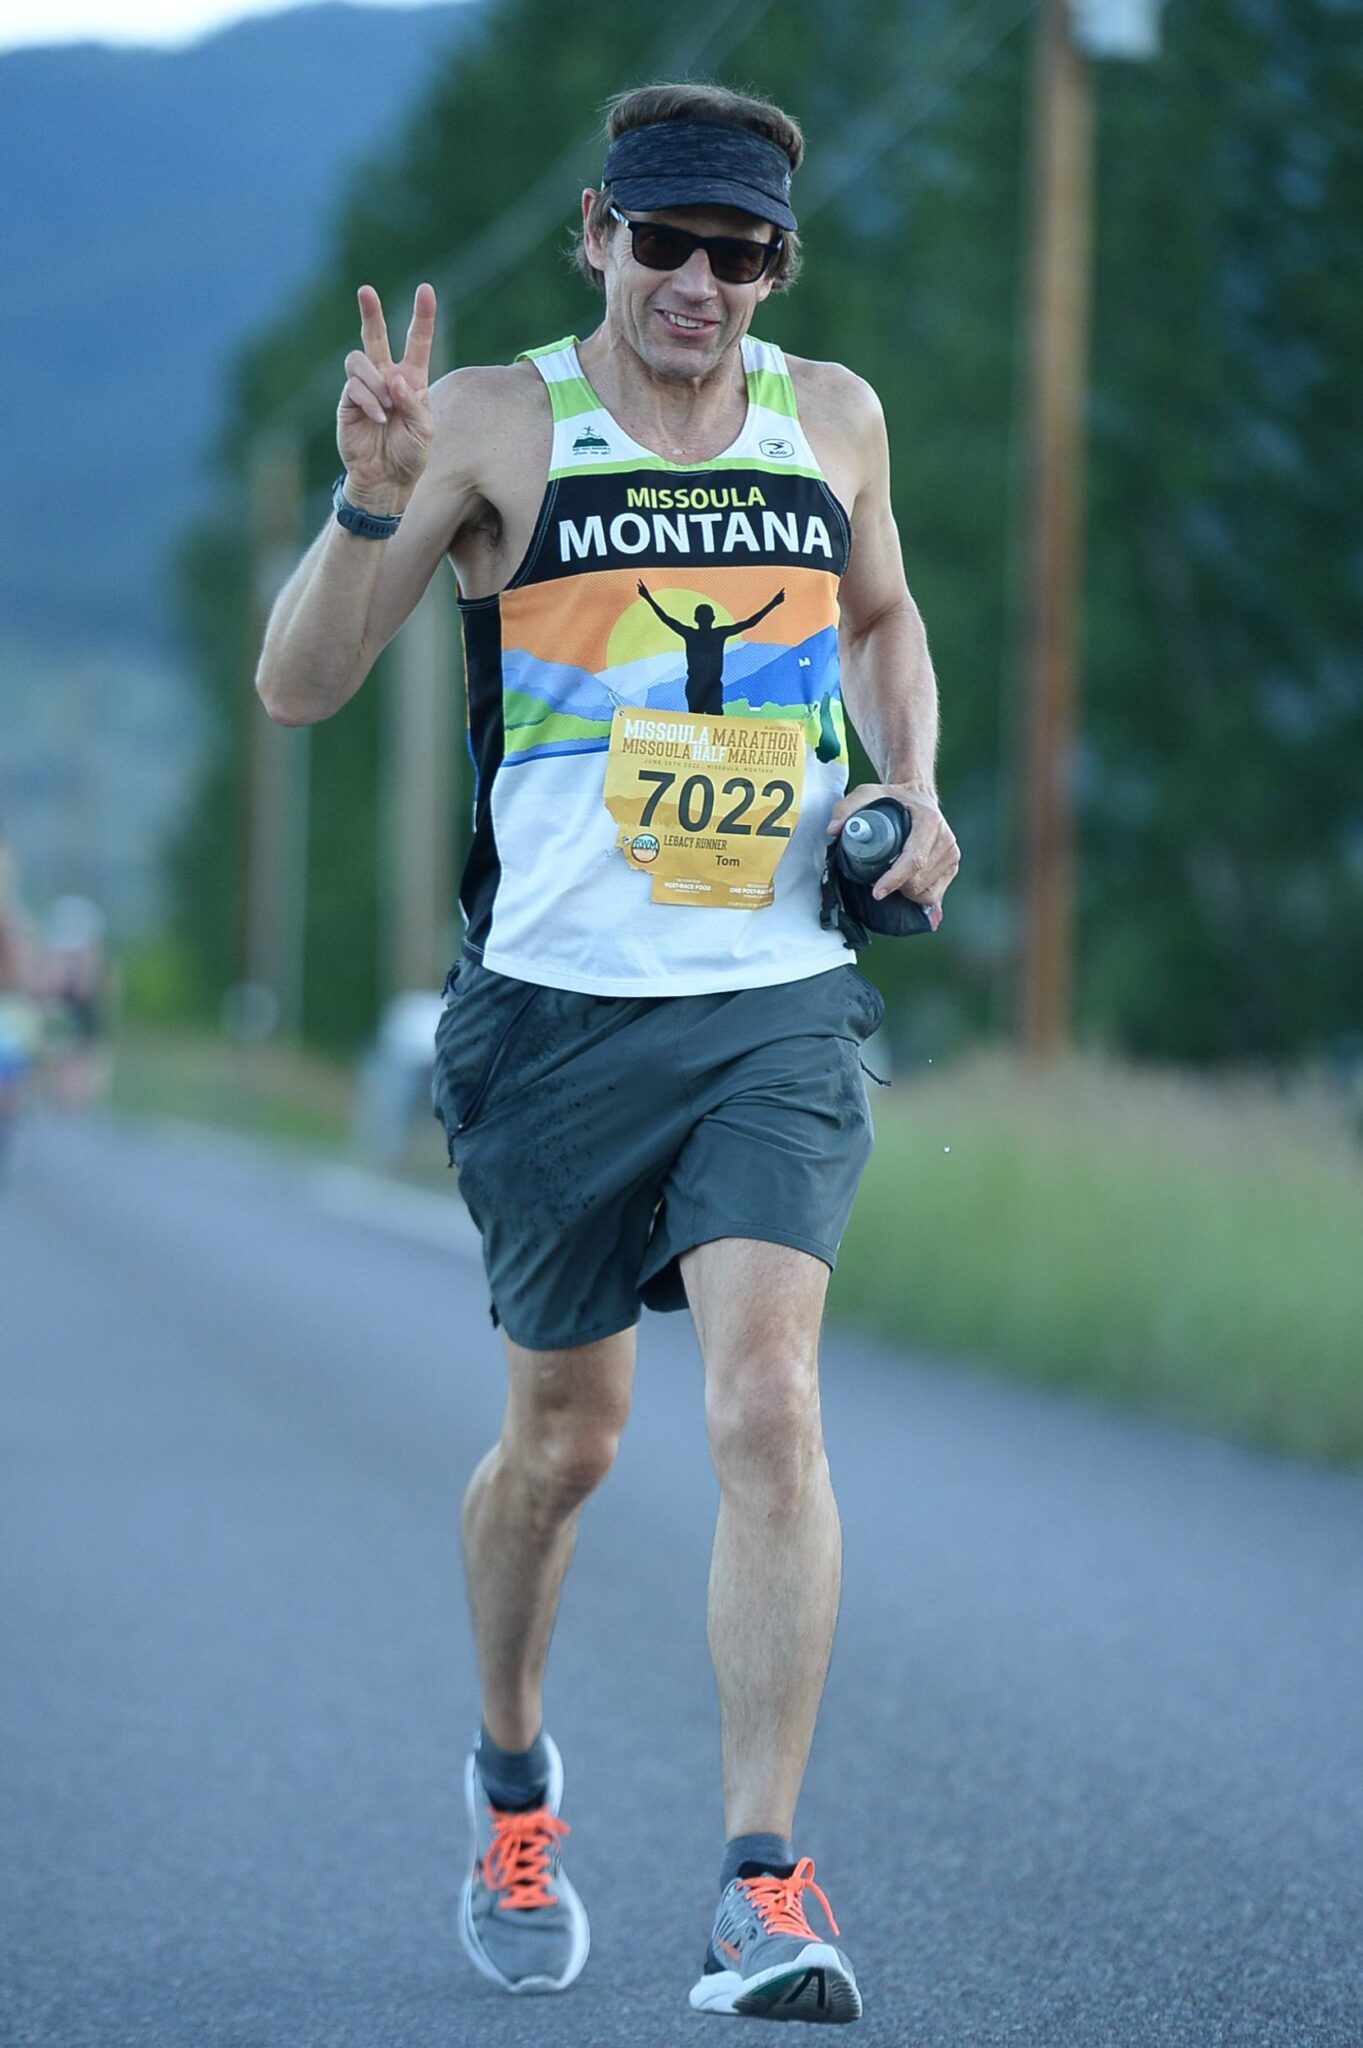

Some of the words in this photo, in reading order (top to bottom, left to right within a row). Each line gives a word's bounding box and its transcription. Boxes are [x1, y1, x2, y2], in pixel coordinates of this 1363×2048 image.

[627, 486, 766, 509] MISSOULA
[558, 511, 833, 562] MONTANA
[624, 718, 710, 744] MISSOULA
[712, 728, 799, 751] MARATHON
[622, 738, 690, 760] MISSOULA
[692, 743, 727, 762] HALF
[727, 748, 797, 767] MARATHON
[638, 769, 794, 838] 7022
[663, 834, 695, 848] LEGACY
[695, 838, 728, 850] RUNNER
[716, 855, 741, 867] Tom
